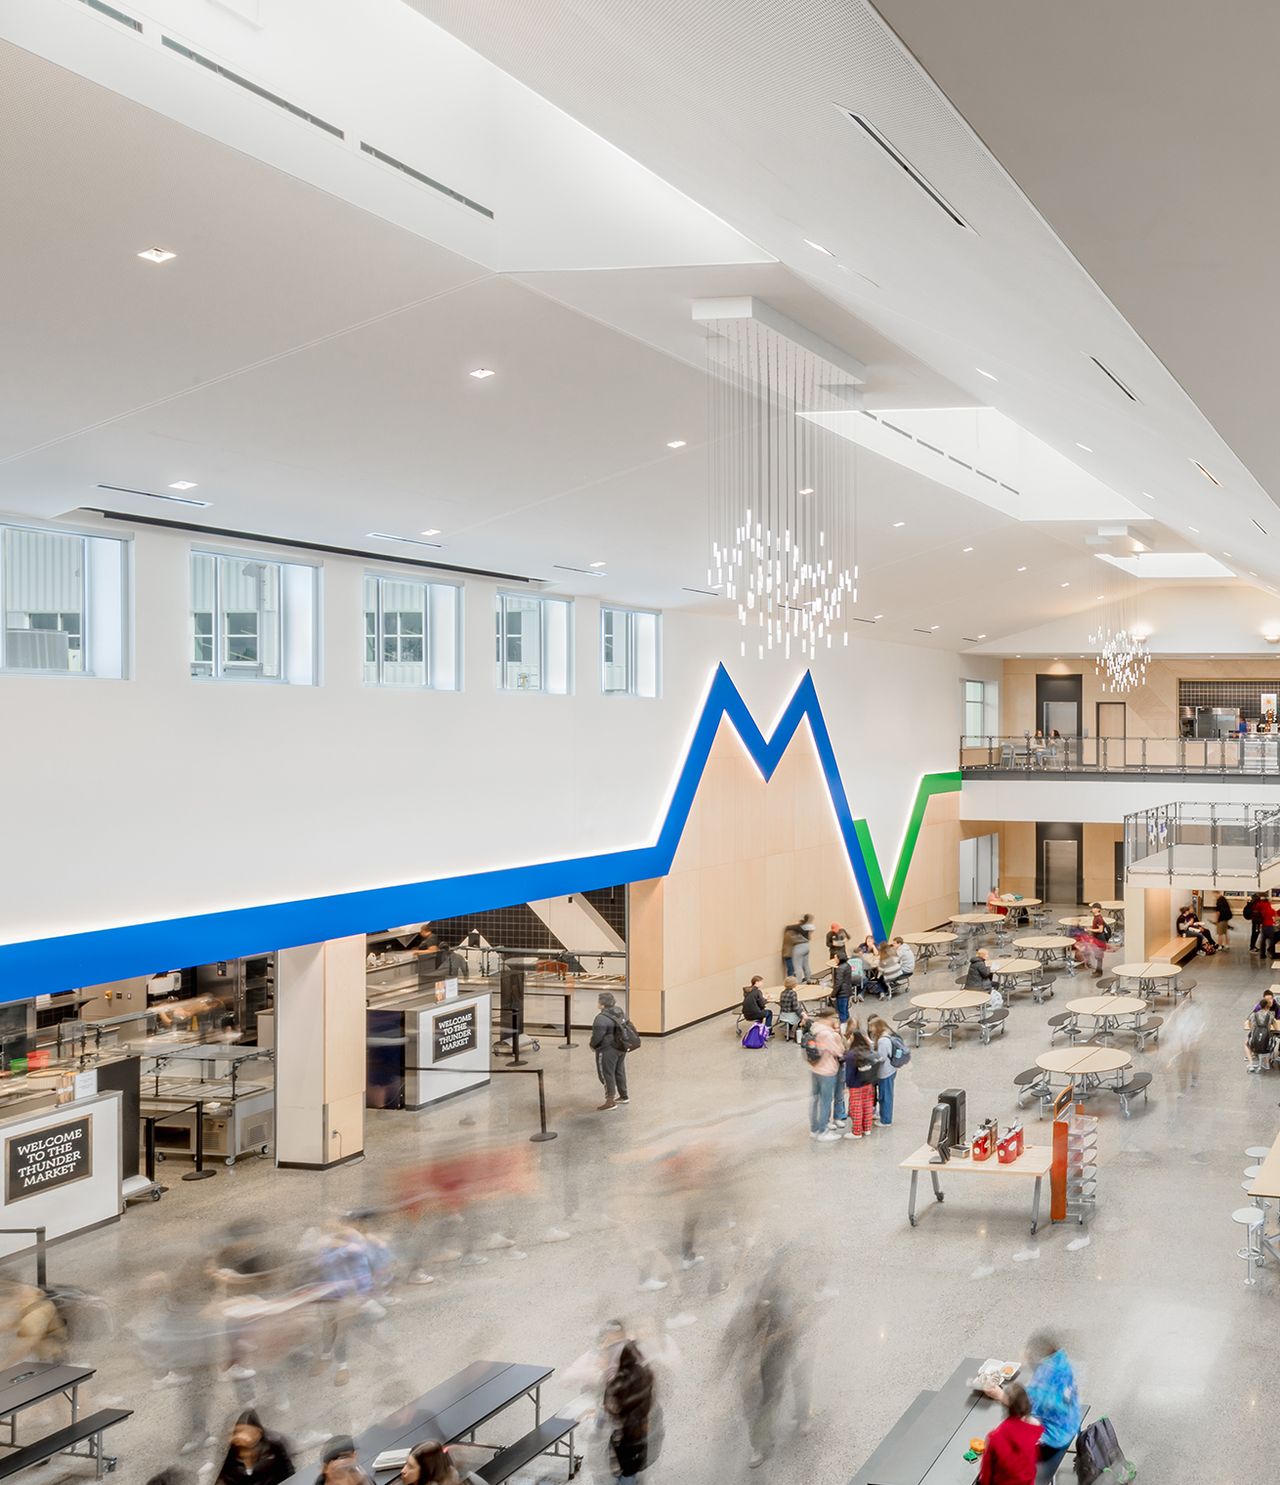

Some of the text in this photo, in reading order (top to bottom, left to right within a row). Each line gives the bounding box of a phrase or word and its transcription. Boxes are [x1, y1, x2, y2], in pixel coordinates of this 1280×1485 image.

[438, 1013, 472, 1029] WELCOME
[443, 1022, 467, 1036] TO THE
[438, 1029, 472, 1045] THUNDER
[441, 1037, 469, 1052] MARKET
[17, 1128, 83, 1156] WELCOME
[26, 1142, 73, 1163] TO THE
[17, 1150, 82, 1177] THUNDER
[23, 1162, 76, 1187] MARKET
